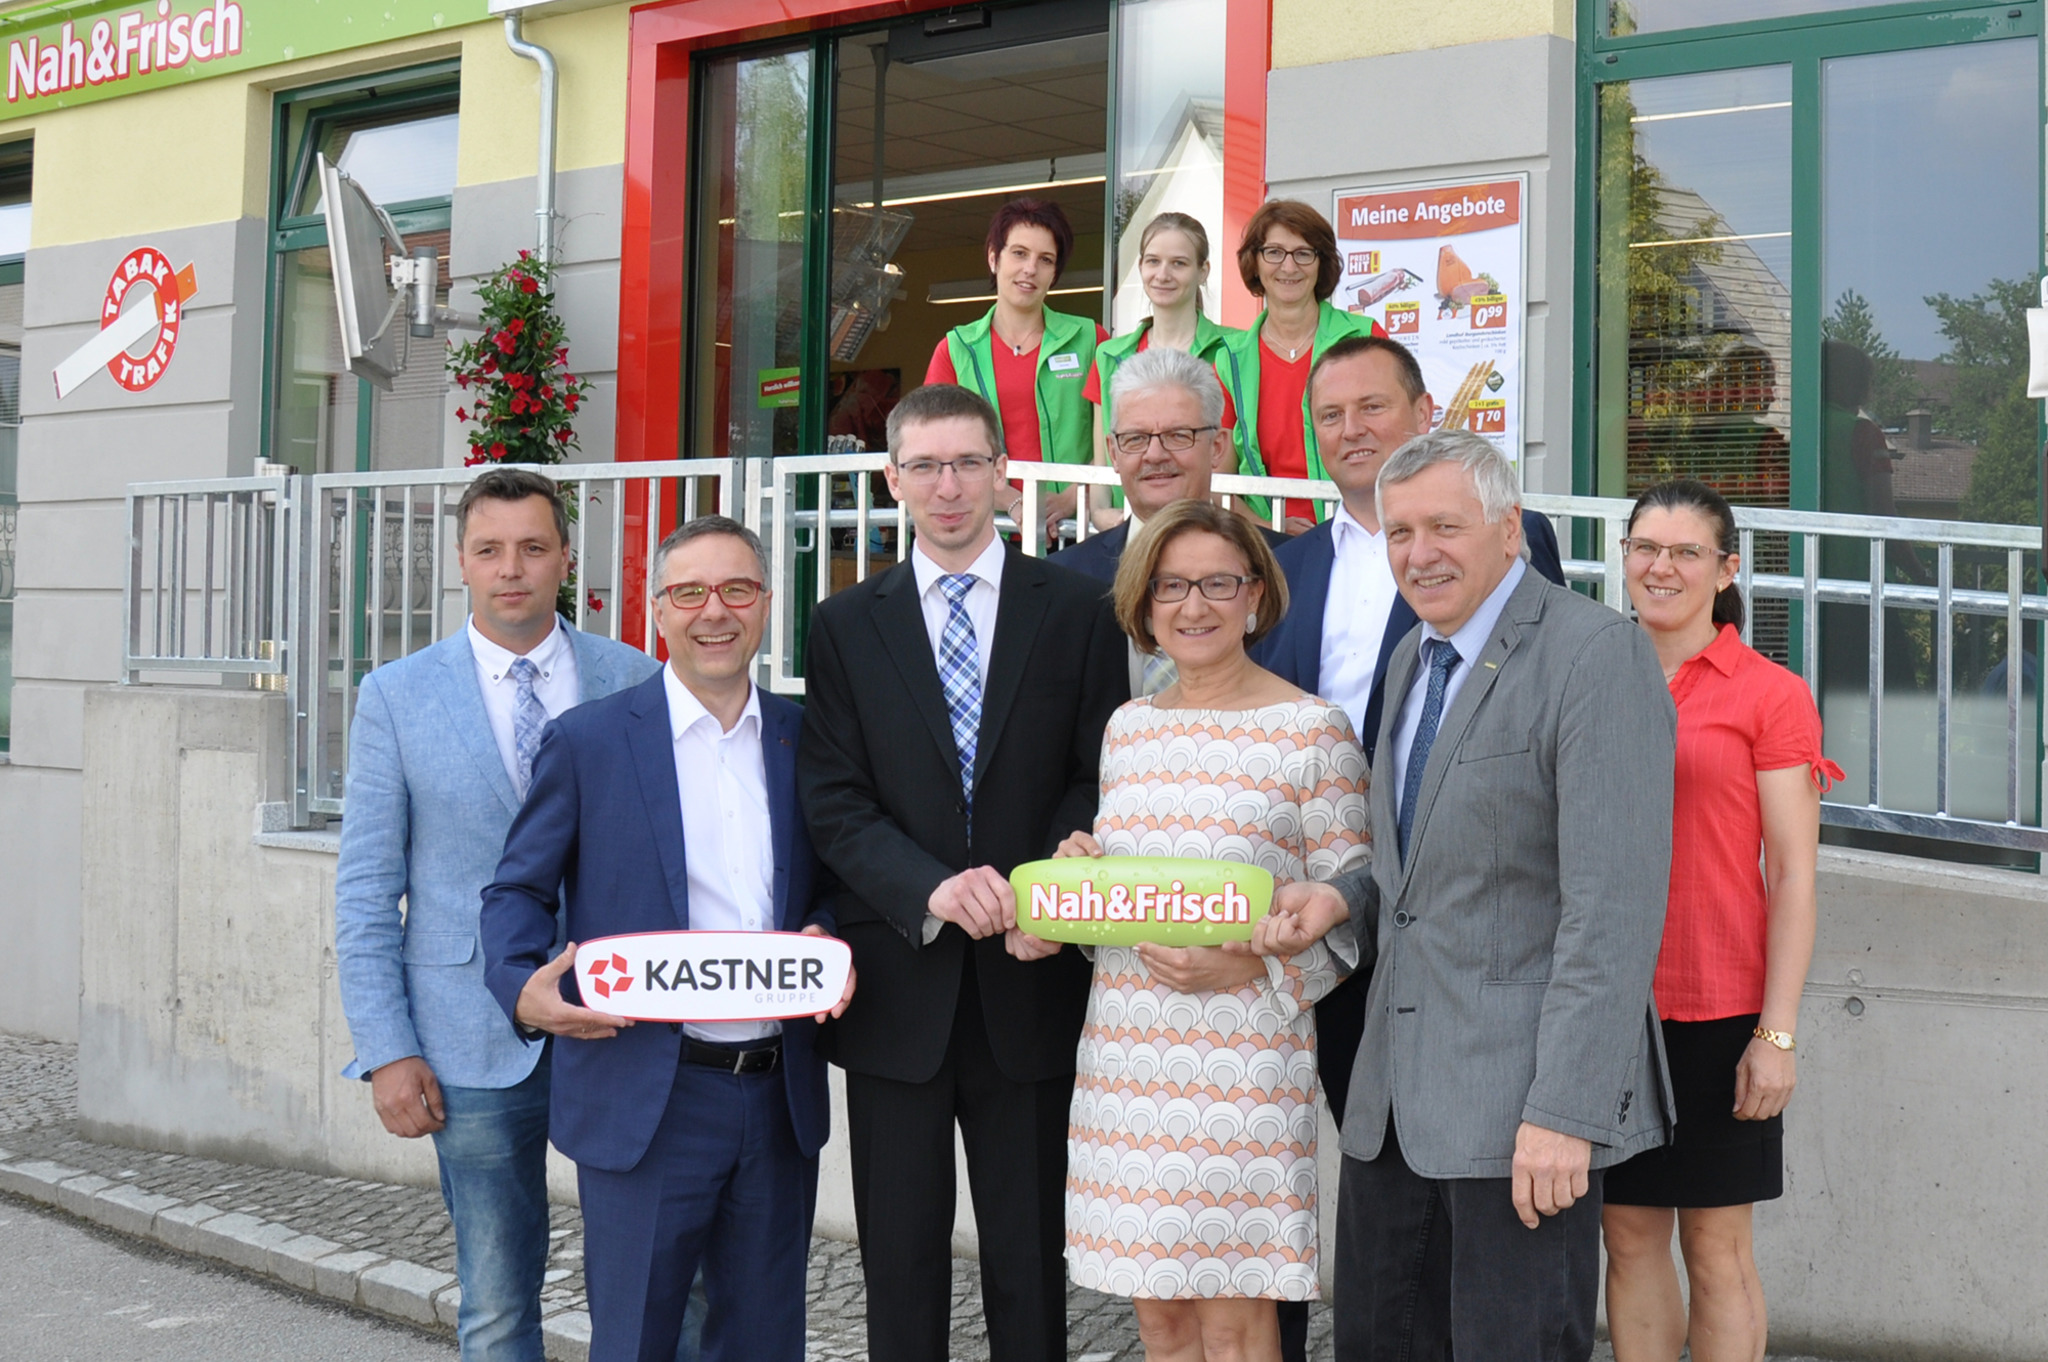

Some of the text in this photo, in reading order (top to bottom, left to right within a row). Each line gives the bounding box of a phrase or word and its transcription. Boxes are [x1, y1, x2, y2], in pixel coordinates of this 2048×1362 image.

[7, 0, 243, 103] Nah&Frisch
[1351, 196, 1506, 227] Meine Angebote
[1349, 253, 1370, 262] PREIS
[105, 252, 169, 318] TABAK
[120, 299, 177, 386] TRAFIK
[1030, 880, 1250, 924] Nah&Frisch
[645, 958, 824, 991] KASTNER
[754, 992, 816, 1004] GRUPPE
